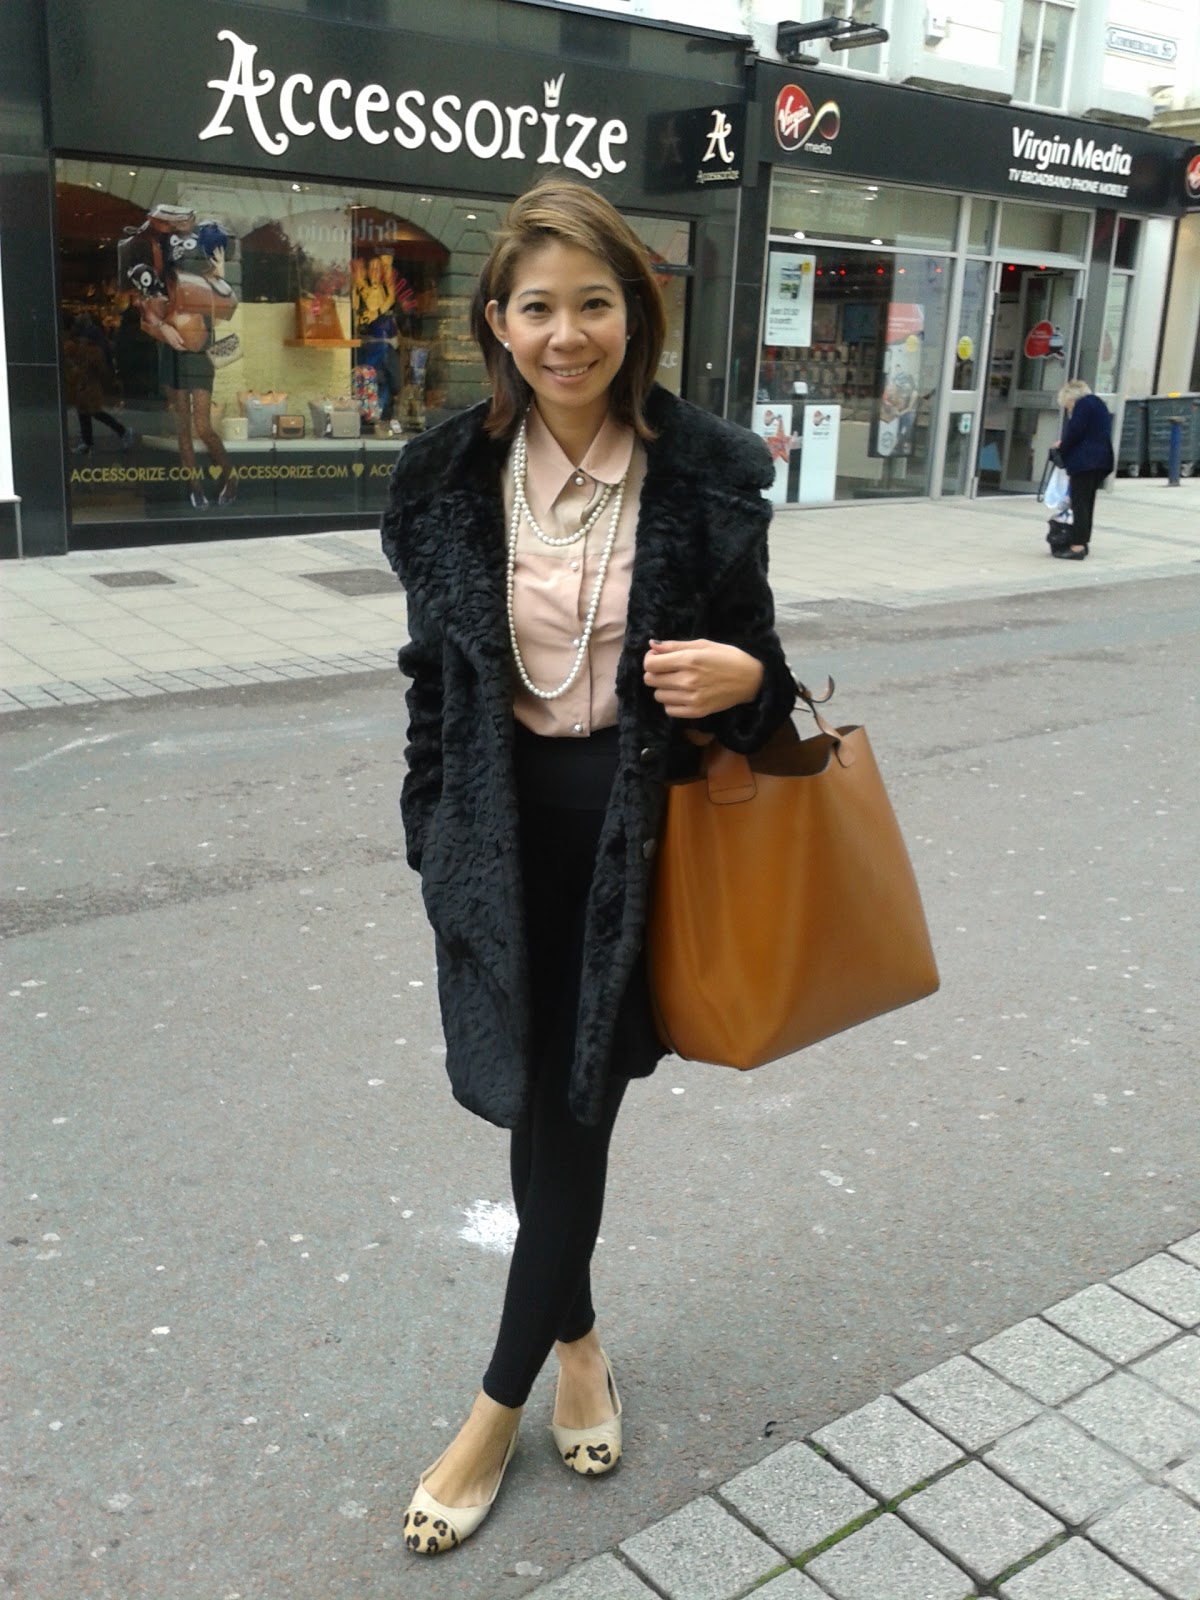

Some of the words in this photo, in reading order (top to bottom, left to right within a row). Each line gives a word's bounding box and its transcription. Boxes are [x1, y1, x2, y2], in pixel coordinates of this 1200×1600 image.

[199, 29, 628, 179] Accessorize
[779, 95, 811, 139] Virgin
[701, 110, 735, 163] A
[804, 142, 832, 155] media
[1012, 126, 1071, 171] Virgin
[1070, 137, 1133, 176] Media
[1008, 168, 1021, 182] TV
[1020, 170, 1072, 190] BROADBAND
[1071, 177, 1100, 194] PHONE
[1099, 182, 1129, 198] MOBILE
[70, 467, 205, 482] ACCESSORIZE.COM
[229, 464, 349, 480] ACCESSORIZE.COM
